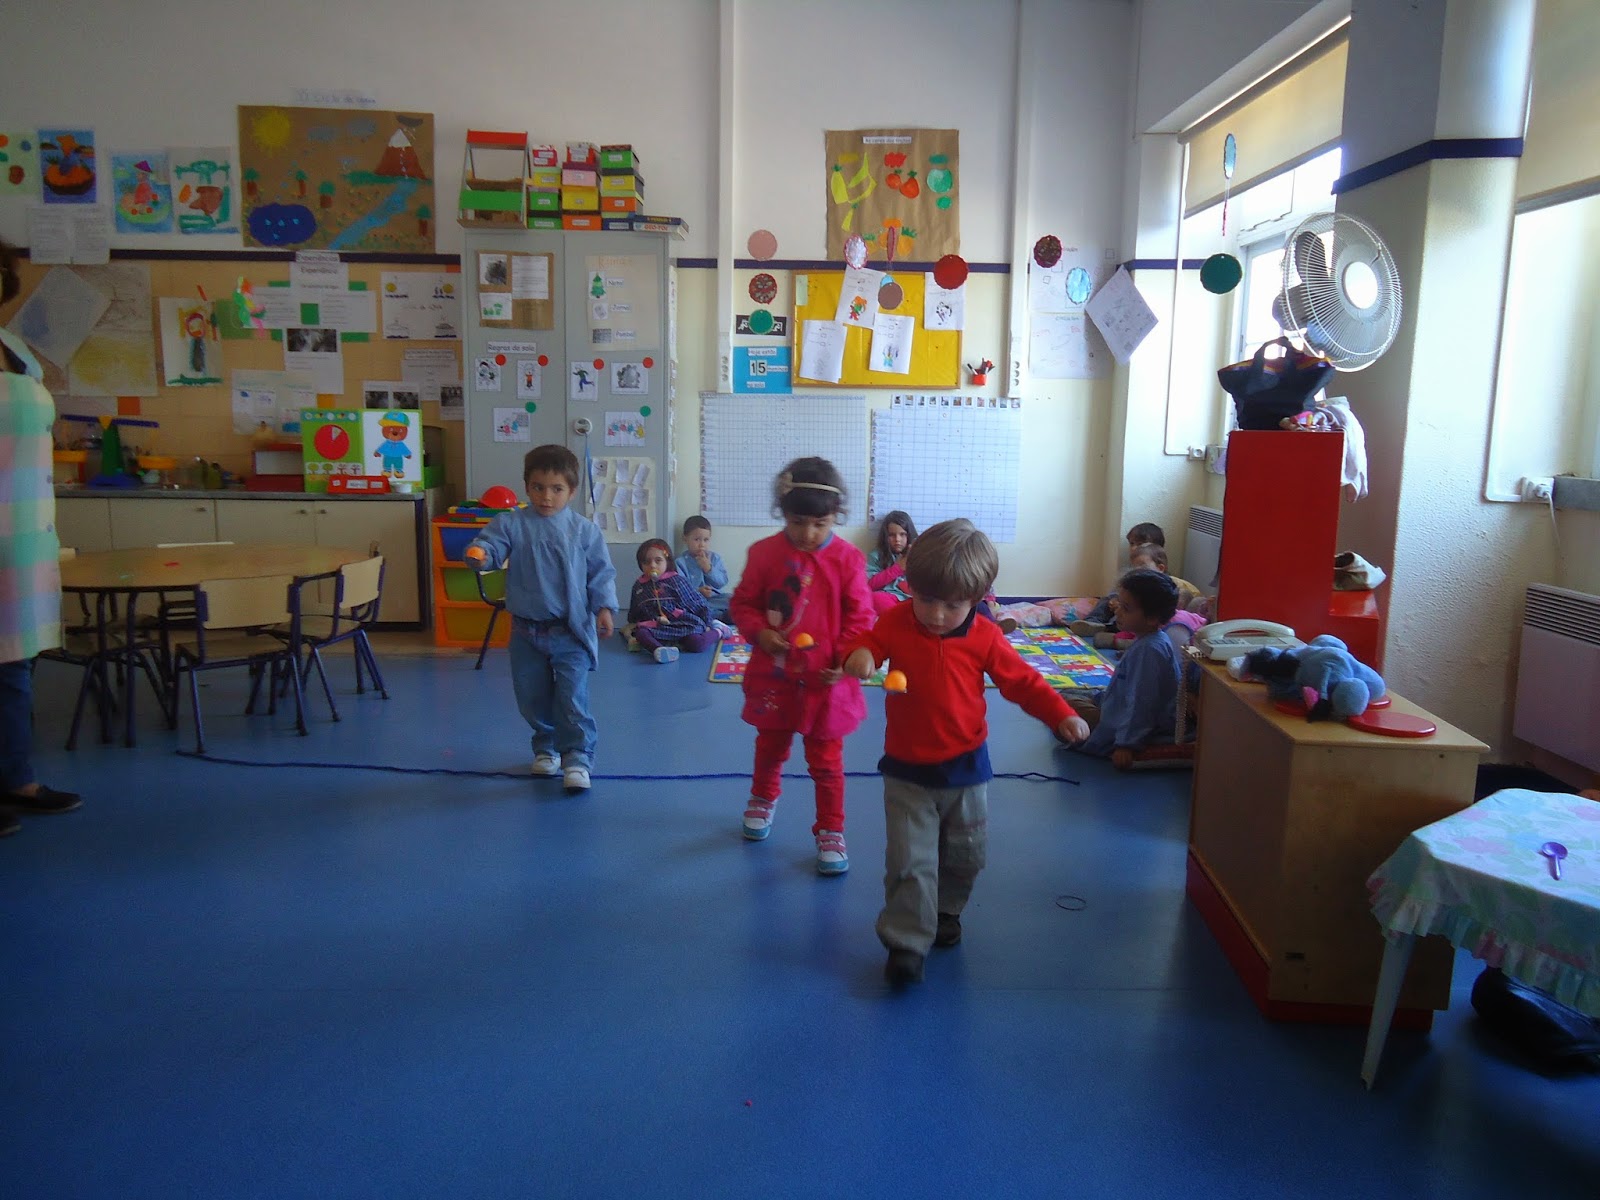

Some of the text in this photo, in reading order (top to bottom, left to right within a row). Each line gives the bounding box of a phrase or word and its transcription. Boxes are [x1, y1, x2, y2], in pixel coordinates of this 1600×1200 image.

[488, 343, 511, 353] Regras
[512, 344, 521, 352] de
[751, 362, 766, 374] 15
